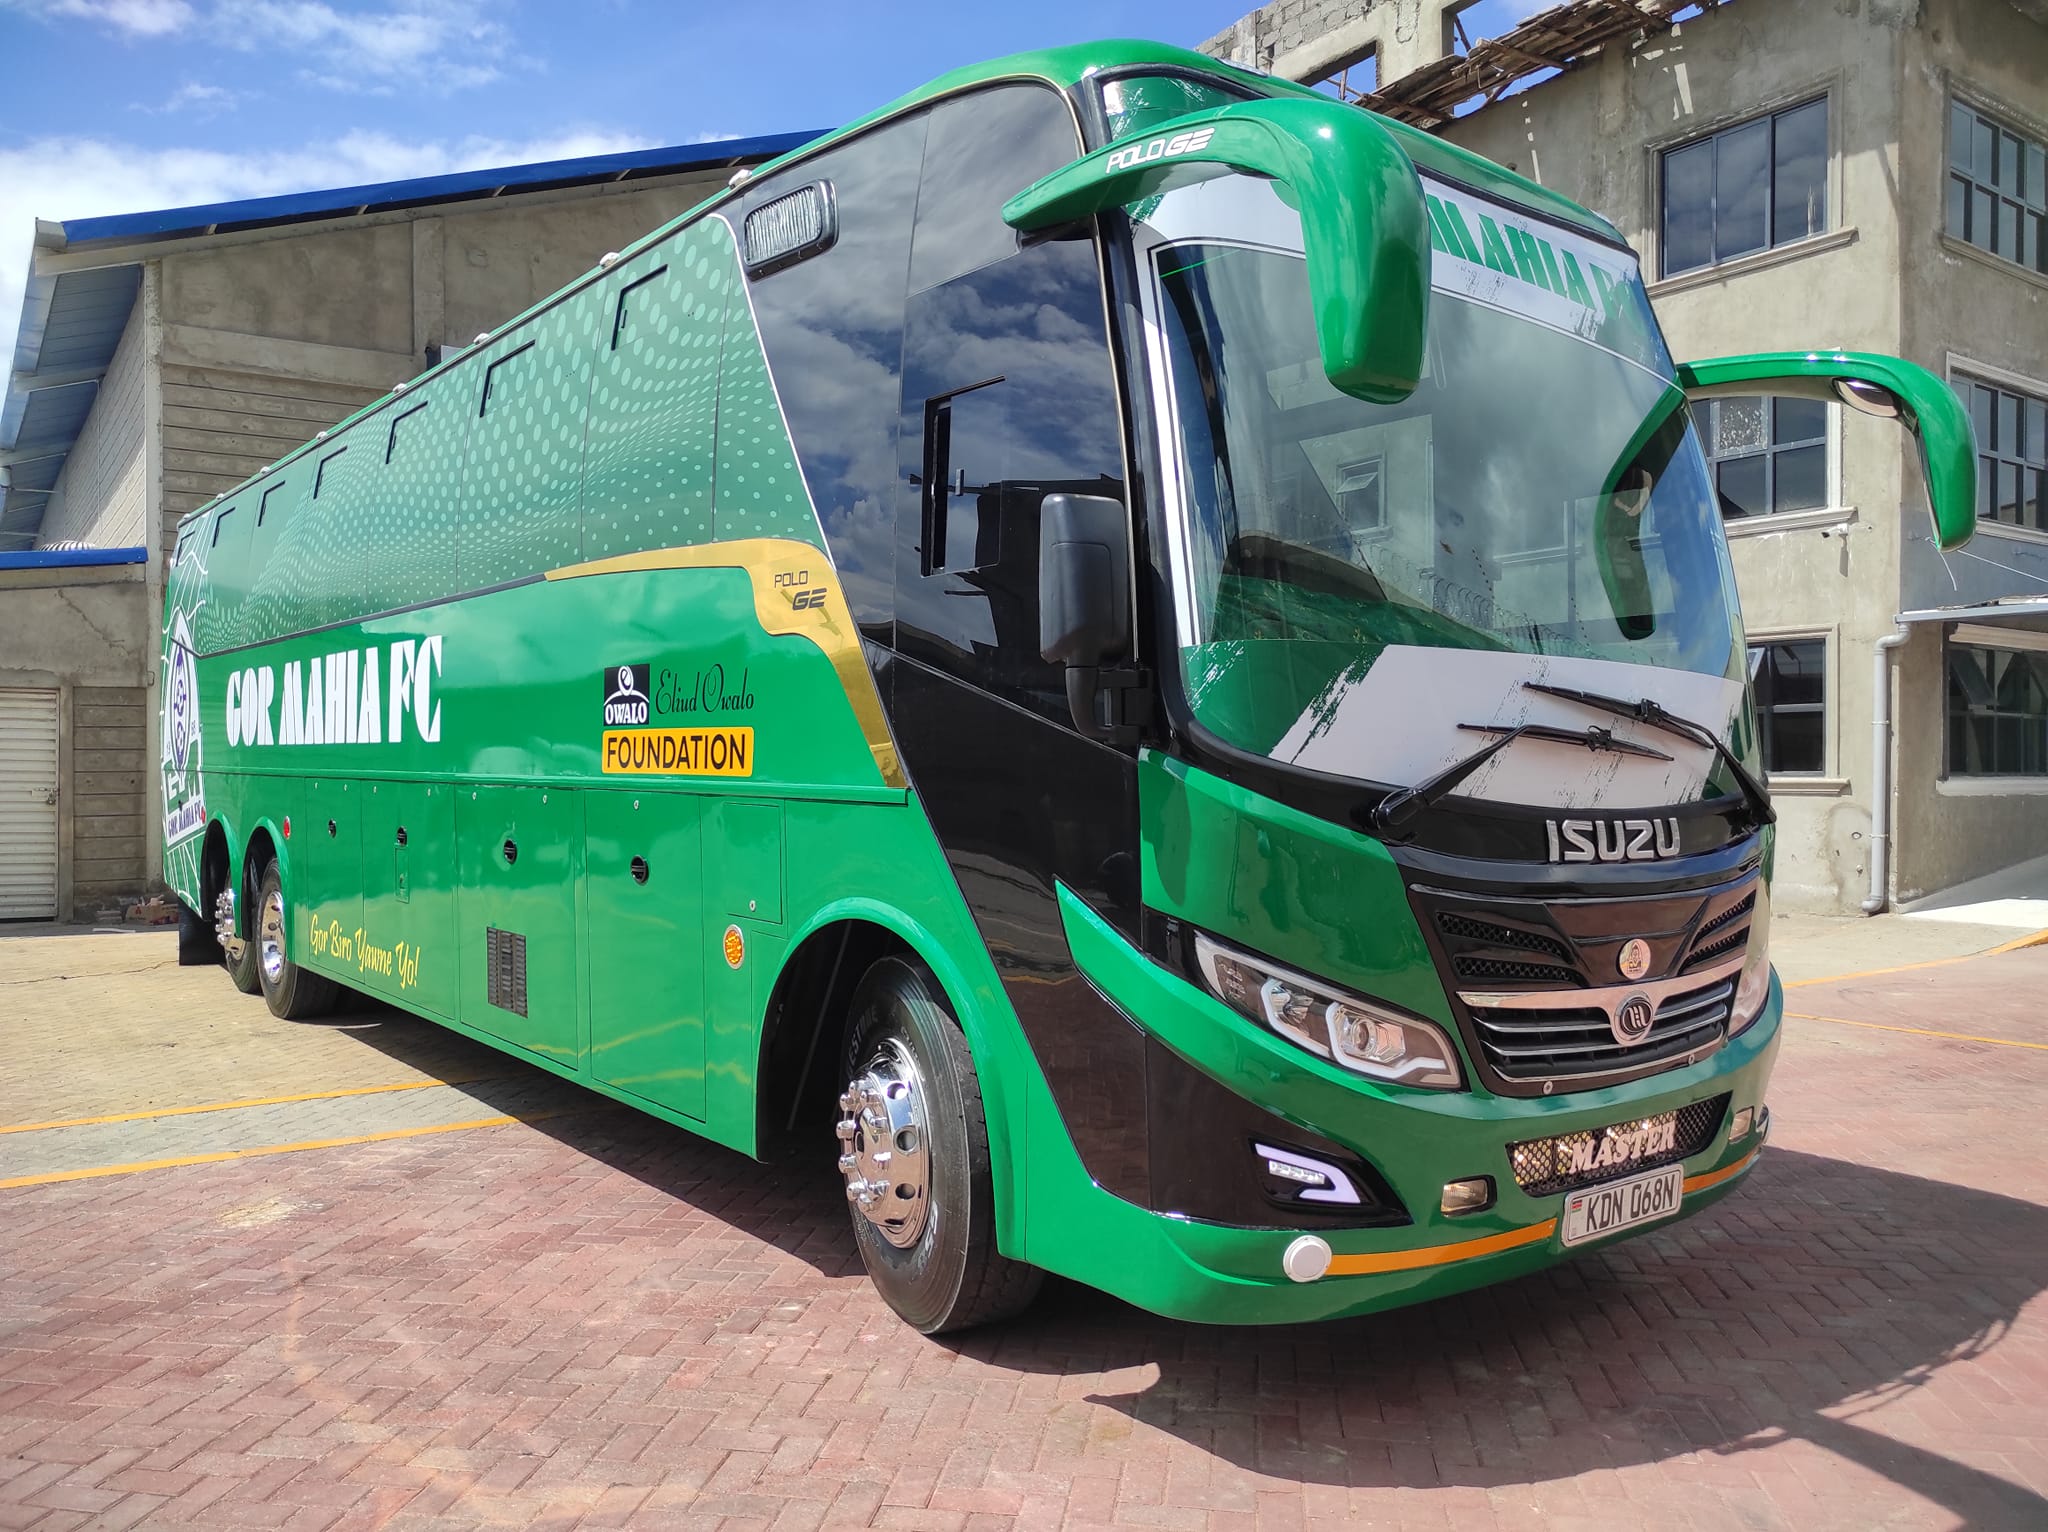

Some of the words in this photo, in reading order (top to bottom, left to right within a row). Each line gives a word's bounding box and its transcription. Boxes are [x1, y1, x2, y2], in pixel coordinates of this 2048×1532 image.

[1105, 138, 1166, 174] POLO
[774, 570, 809, 588] POLO
[225, 664, 275, 747] GOR
[278, 646, 382, 745] MAHIA
[388, 634, 443, 743] FC
[605, 701, 648, 725] OWALO
[655, 668, 701, 715] Eliud
[702, 663, 755, 713] Owalo
[607, 733, 746, 770] FOUNDATION
[1545, 817, 1681, 863] ISUZU
[310, 913, 328, 956] Gor
[329, 919, 352, 962] Biro
[354, 927, 392, 976] Yawne
[395, 940, 420, 990] Yo!
[1568, 1119, 1676, 1175] MASTER
[1586, 1188, 1623, 1233] KDN
[1629, 1173, 1676, 1219] 068N
